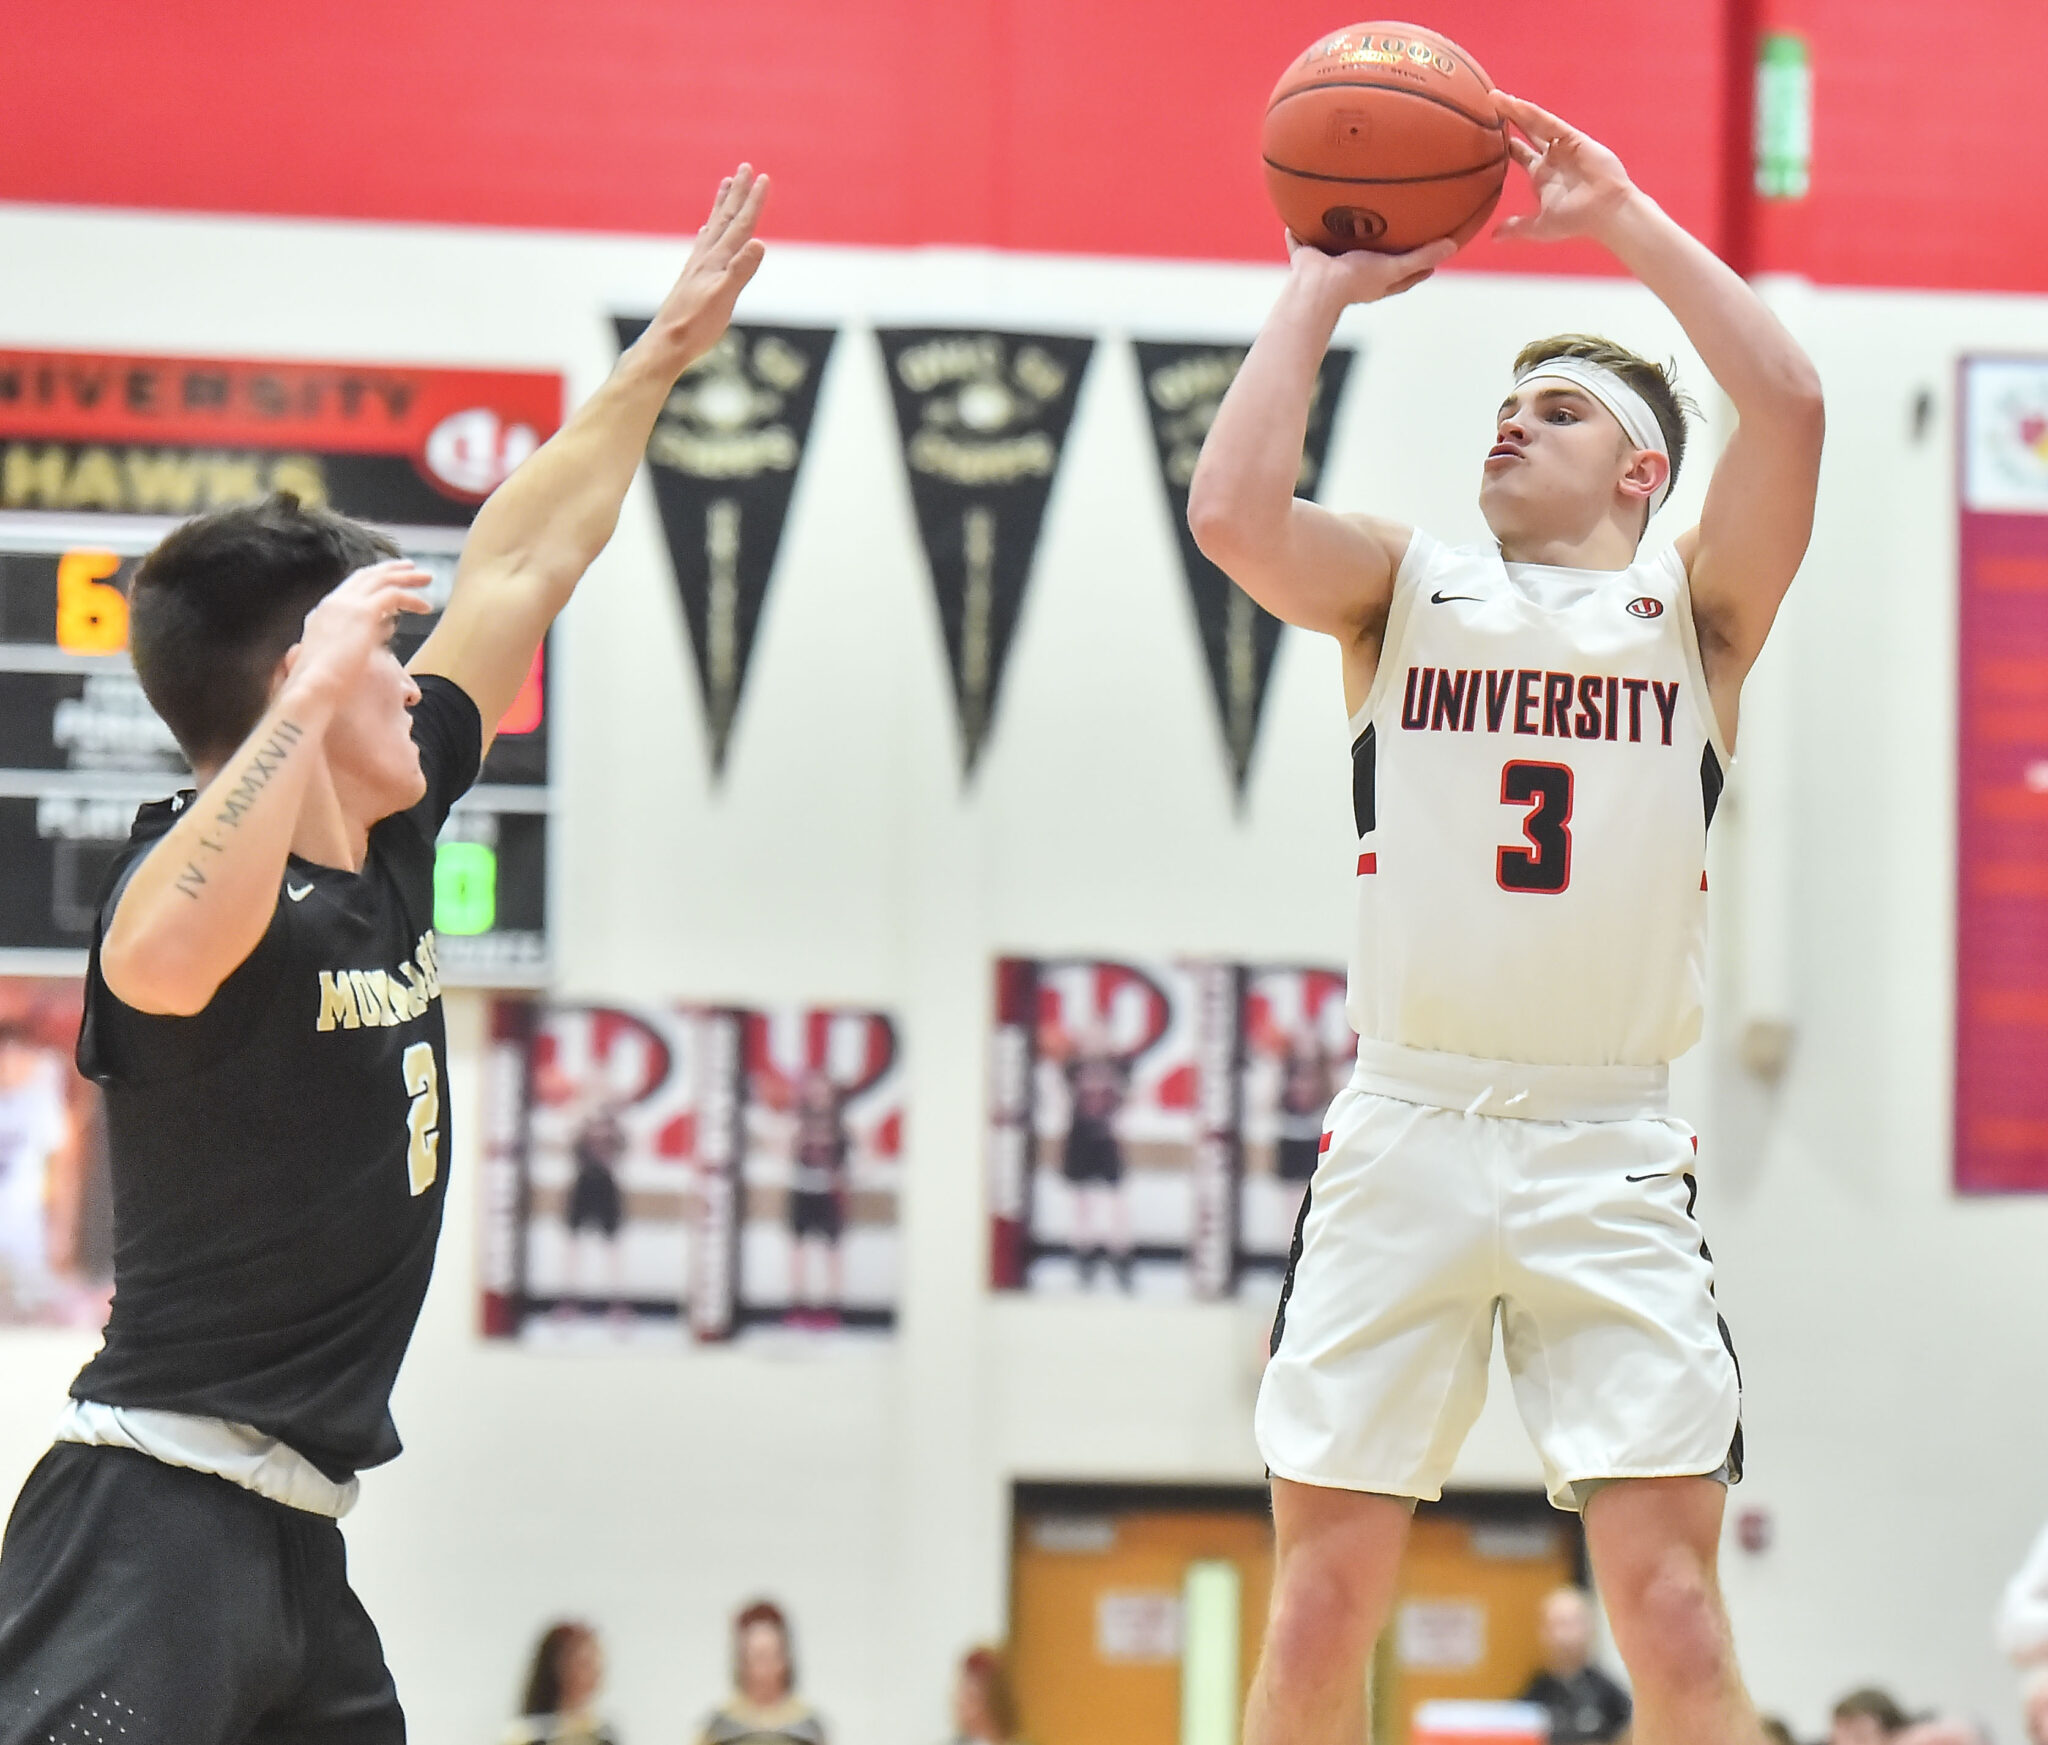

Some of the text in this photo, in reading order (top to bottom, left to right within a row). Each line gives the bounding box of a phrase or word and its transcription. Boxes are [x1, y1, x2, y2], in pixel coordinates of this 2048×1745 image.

[1401, 667, 1680, 746] UNIVERSITY
[1496, 759, 1575, 895] 3
[402, 1041, 440, 1197] 2
